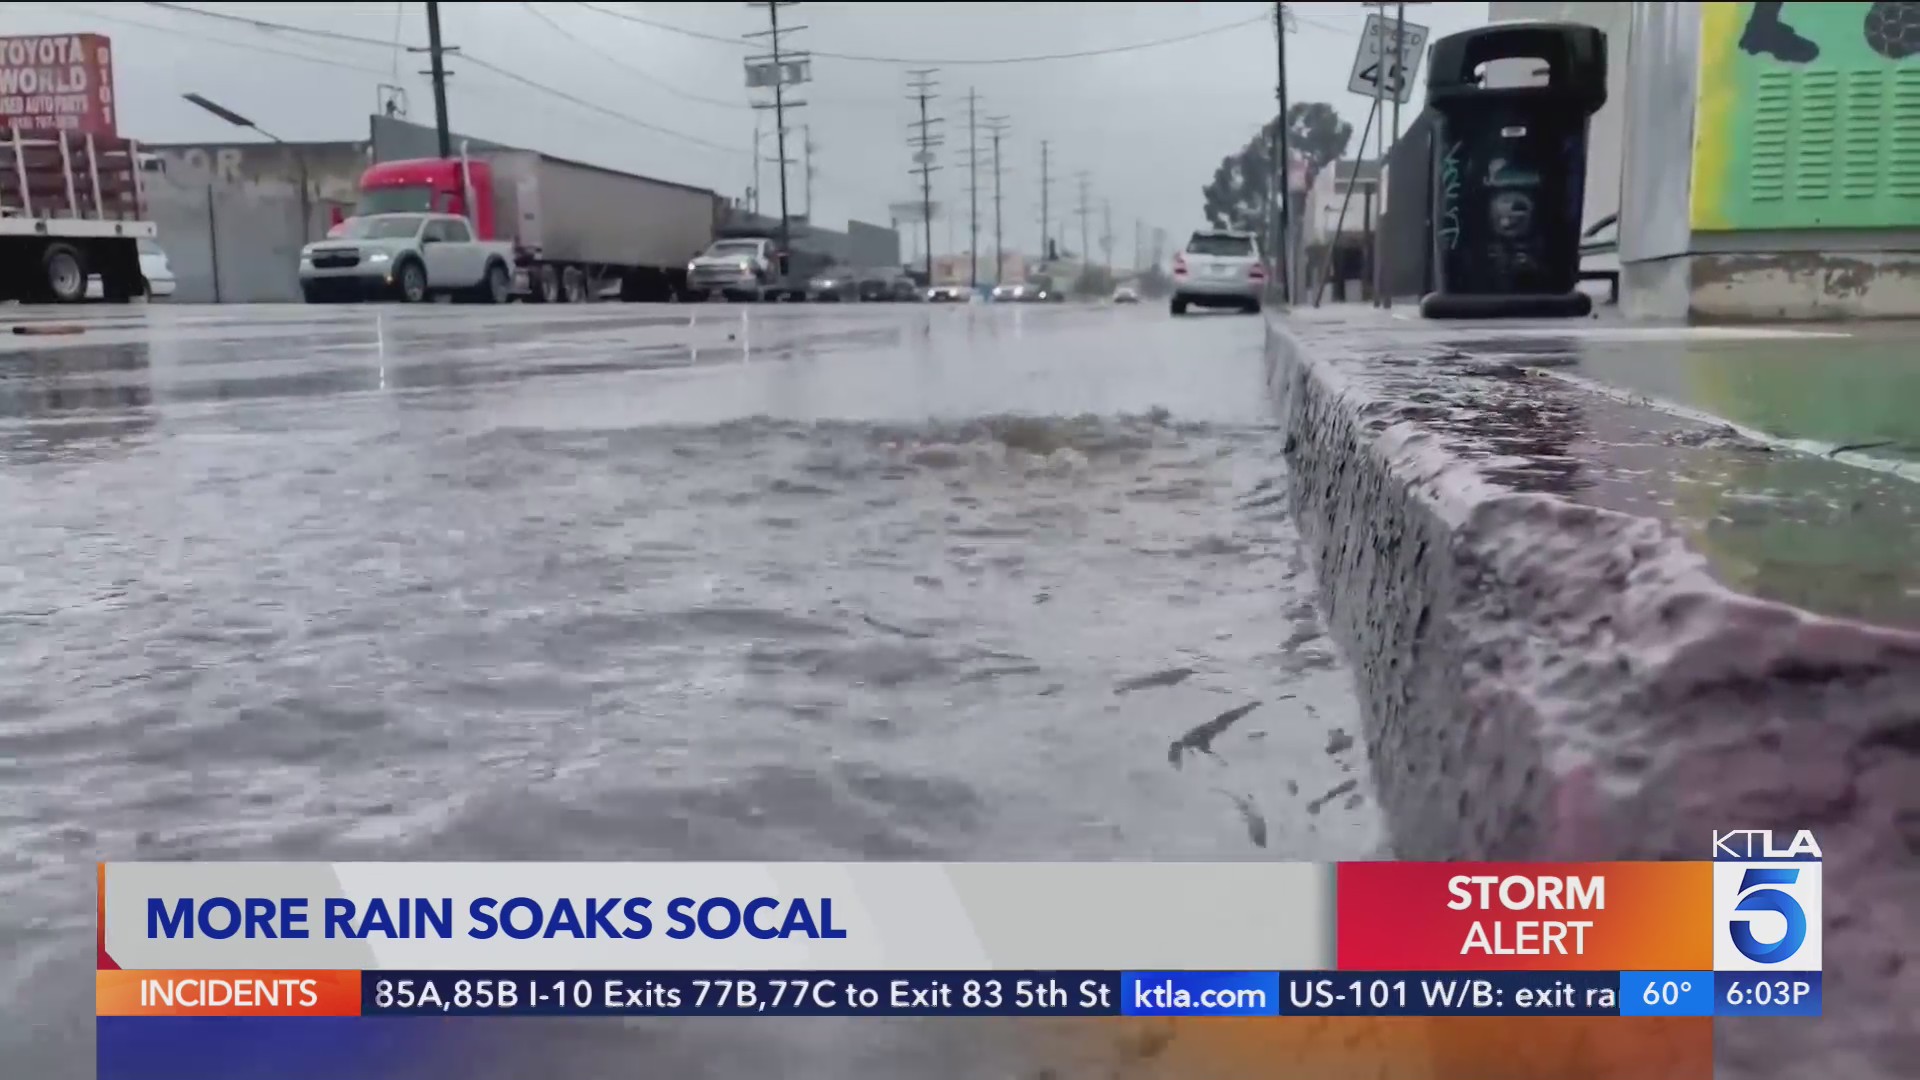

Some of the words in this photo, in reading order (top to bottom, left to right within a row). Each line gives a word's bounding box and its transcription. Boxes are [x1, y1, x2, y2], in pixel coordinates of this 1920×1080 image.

[0, 37, 84, 65] TOYOTA
[0, 66, 87, 93] WORLD
[1359, 62, 1408, 92] 45
